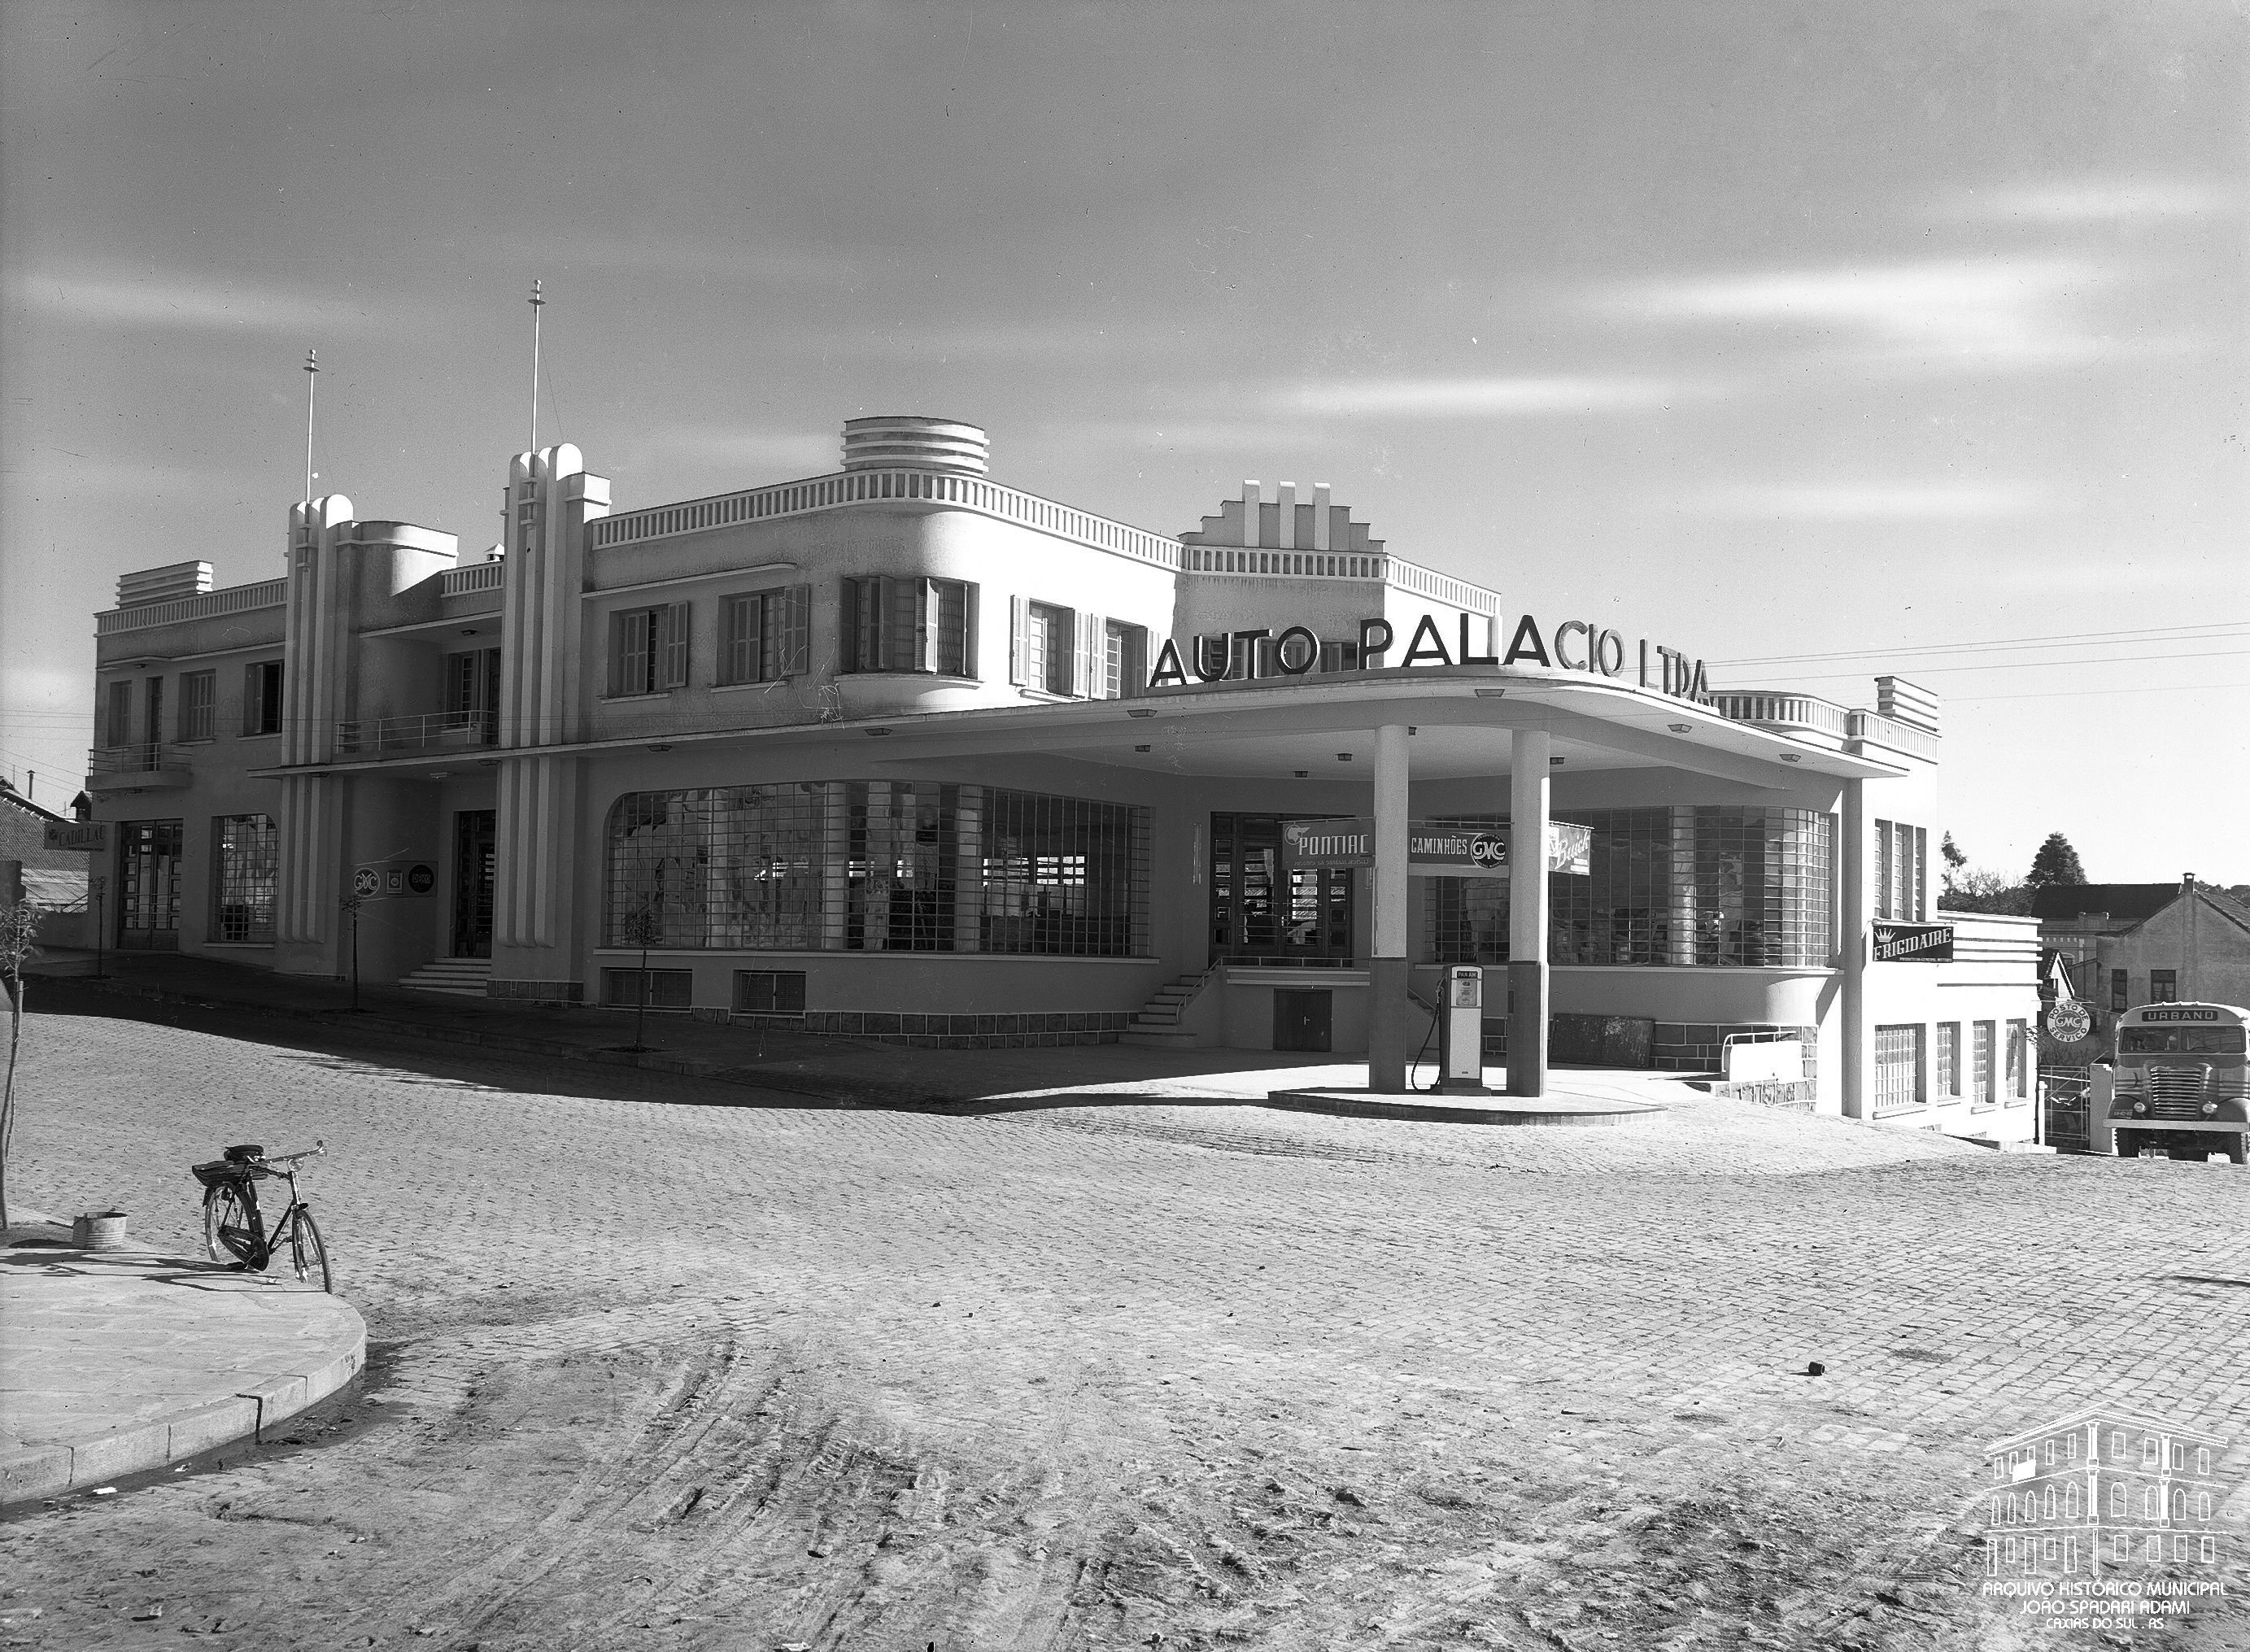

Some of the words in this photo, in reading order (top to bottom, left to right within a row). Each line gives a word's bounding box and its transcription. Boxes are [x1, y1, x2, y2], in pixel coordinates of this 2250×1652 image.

[1149, 625, 1319, 687] AUTO
[1358, 612, 1624, 678] PALACIO
[1639, 639, 1714, 707] LTDA
[59, 825, 106, 847] CADILLAC
[1298, 834, 1369, 856] PONTIAC
[1411, 835, 1467, 855] CAMINHÕES
[1472, 841, 1506, 860] GMC
[1554, 829, 1590, 870] Buick
[353, 873, 377, 891] GMC
[1873, 927, 1951, 961] FRIGIDAIRE
[2048, 1004, 2078, 1020] POSTO
[2078, 1009, 2089, 1022] DE
[2056, 1017, 2082, 1028] GMC
[2148, 1011, 2213, 1021] URBANO
